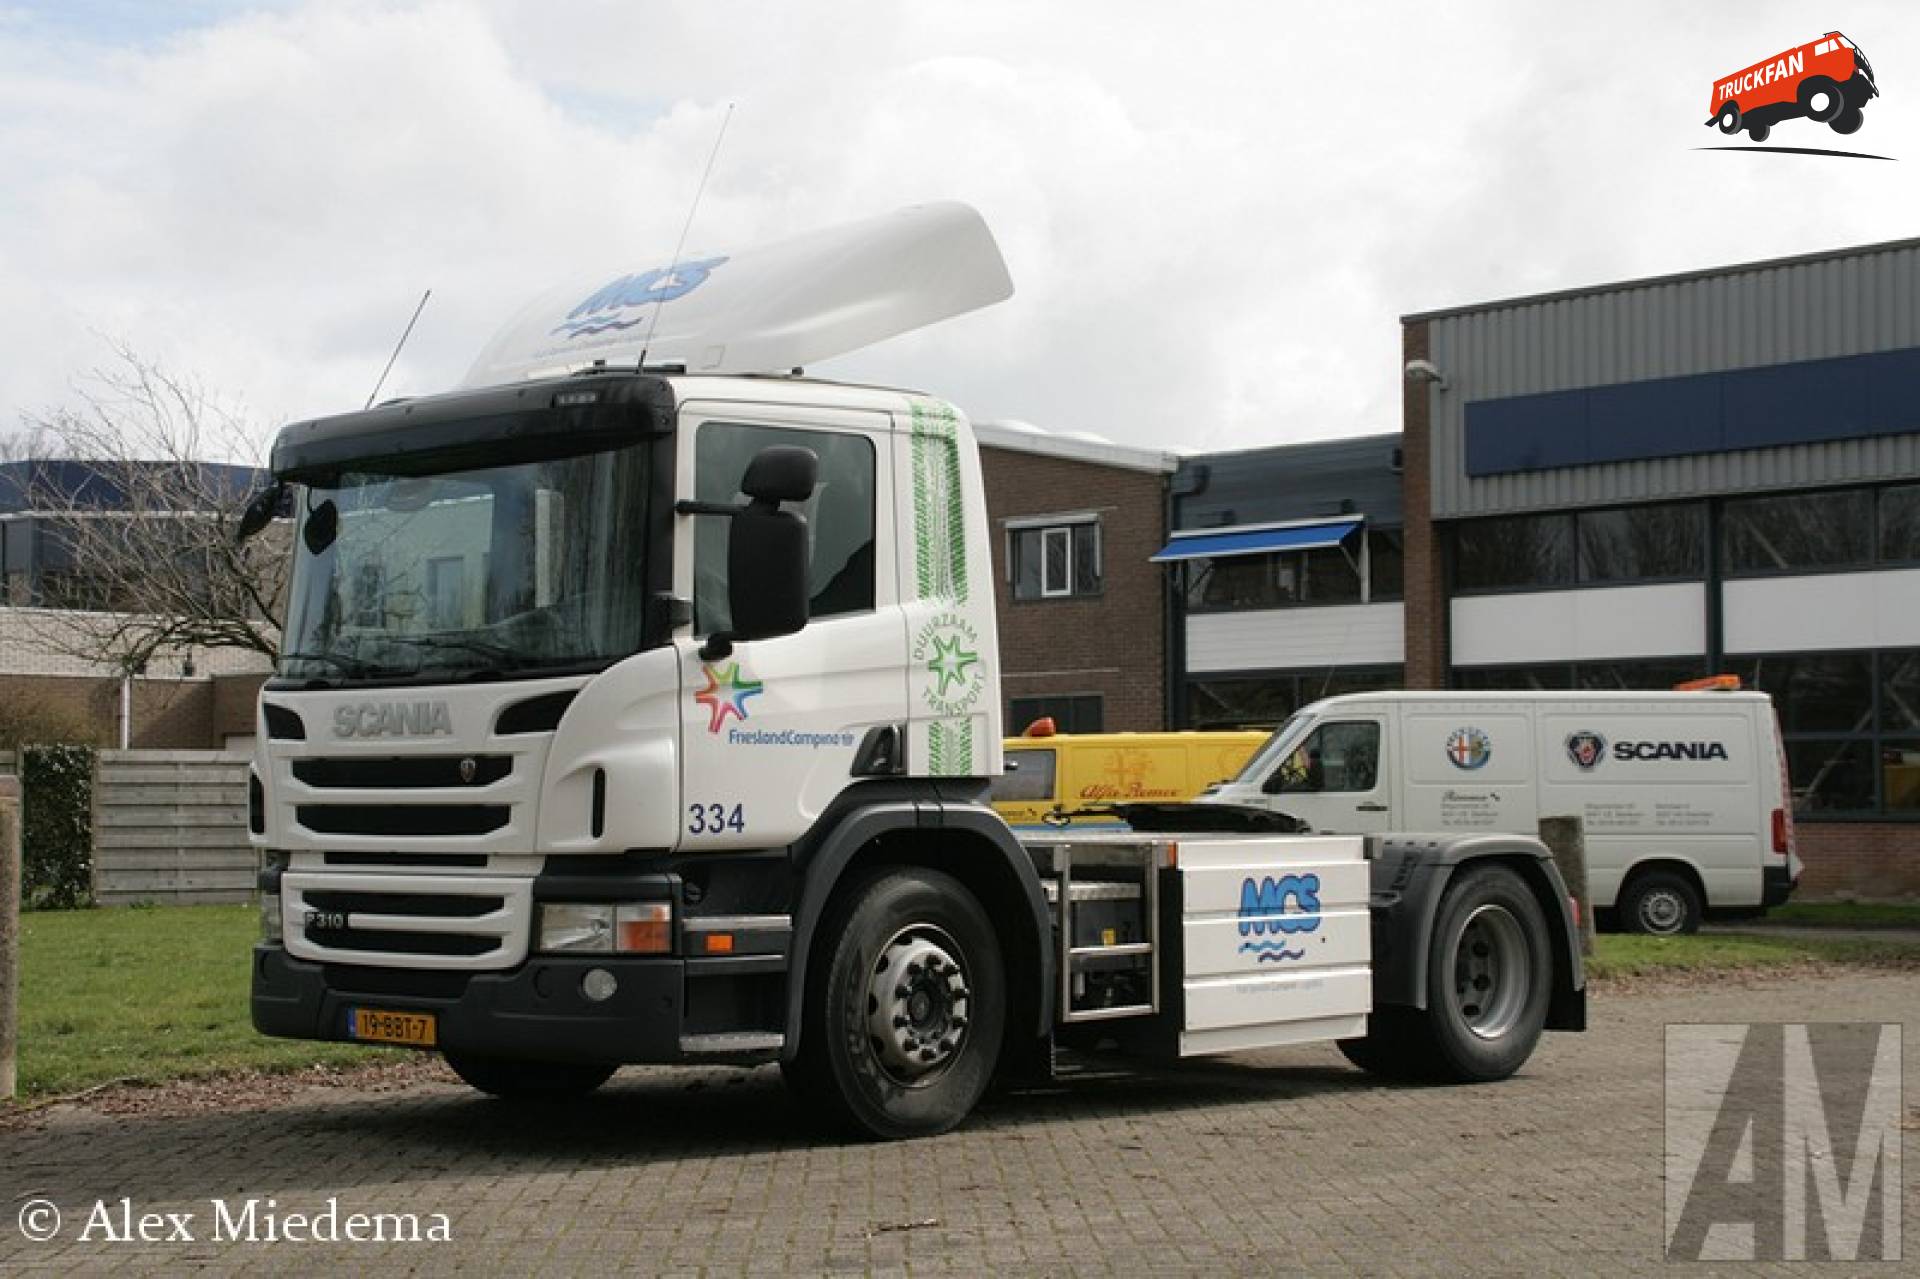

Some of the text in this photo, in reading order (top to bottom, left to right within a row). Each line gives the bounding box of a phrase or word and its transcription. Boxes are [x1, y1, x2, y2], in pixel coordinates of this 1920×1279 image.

[333, 701, 452, 738] SCANIA
[729, 729, 839, 748] FrieslandCampina
[1613, 741, 1728, 761] SCANIA
[688, 803, 745, 834] 334
[1238, 873, 1321, 936] MCS
